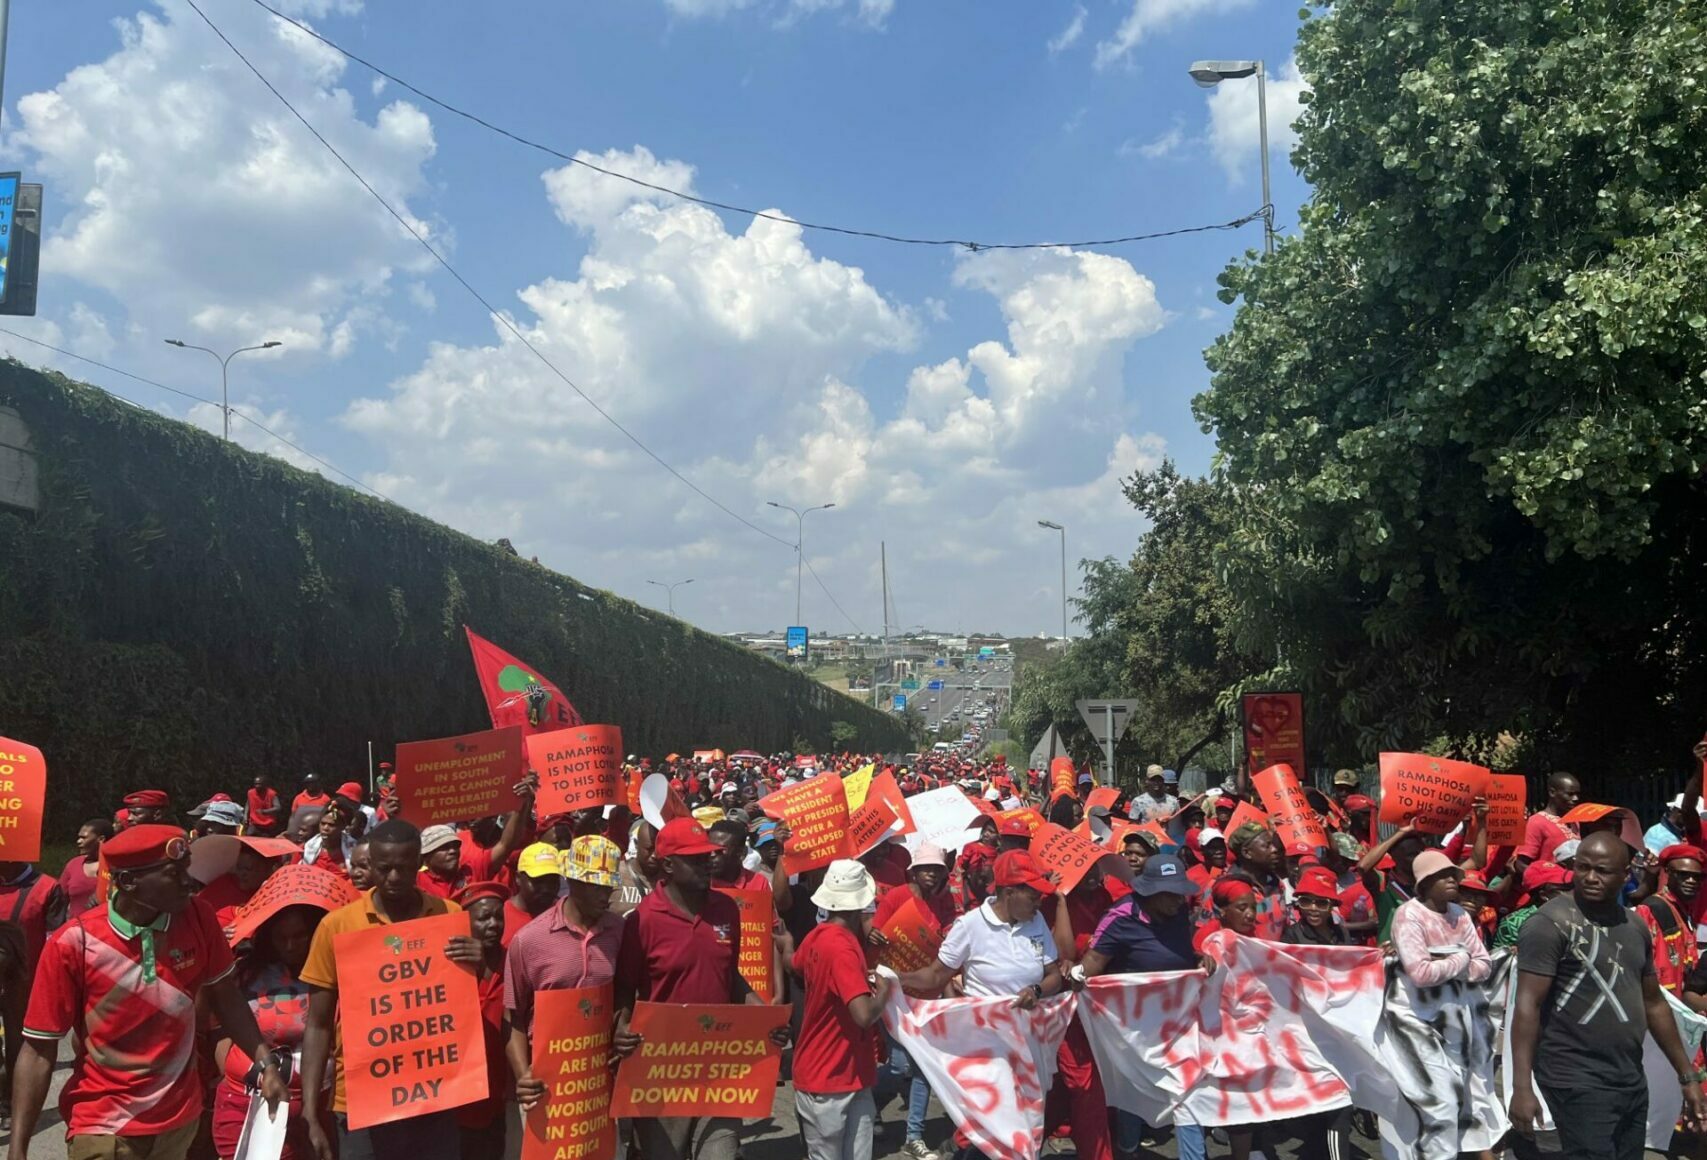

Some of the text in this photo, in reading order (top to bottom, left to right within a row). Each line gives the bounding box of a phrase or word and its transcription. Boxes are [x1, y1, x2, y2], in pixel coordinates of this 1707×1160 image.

[414, 750, 507, 773] UNEMPLOYMENT
[548, 766, 560, 777] IS
[563, 761, 591, 775] NOT
[434, 767, 490, 784] IN SOUTH
[552, 780, 570, 792] TO
[573, 774, 595, 787] HIS
[1398, 769, 1472, 794] RAMAPHOSA
[0, 781, 15, 793] R
[414, 776, 507, 797] AFRICA CANNOT
[786, 788, 823, 804] HAVE A
[788, 777, 828, 796] CANNOT
[1397, 782, 1467, 807] IS NOT LOYAL
[421, 790, 500, 809] BE TOLERATED
[564, 793, 582, 804] OF
[784, 794, 833, 816] PRESIDENT
[1291, 799, 1306, 809] UP
[1398, 796, 1460, 819] TO HIS OATH
[431, 803, 490, 820] ANYMORE
[804, 804, 845, 824] PRESIDES
[849, 807, 868, 827] ONEY
[867, 809, 880, 823] HIS
[799, 820, 835, 838] OVER A
[793, 830, 844, 852] COLLAPSED
[810, 846, 836, 860] STATE
[1046, 853, 1058, 864] IS
[1056, 853, 1072, 868] TO
[1074, 852, 1089, 868] OF
[407, 939, 426, 951] EFF
[747, 937, 761, 947] NO
[378, 956, 432, 983] GBV
[370, 984, 448, 1016] IS THE
[367, 1013, 456, 1048] ORDER
[715, 1022, 733, 1032] EFF
[641, 1039, 767, 1057] RAMAPHOSA
[369, 1043, 459, 1079] OF THE
[559, 1052, 608, 1075] ARE NO
[647, 1063, 752, 1080] MUST STEP
[391, 1077, 445, 1107] DAY
[555, 1072, 608, 1097] LONGER
[630, 1087, 760, 1104] DOWN NOW
[545, 1092, 610, 1119] WORKING
[545, 1113, 609, 1141] IN SOUTH
[553, 1138, 600, 1160] AFRICA
